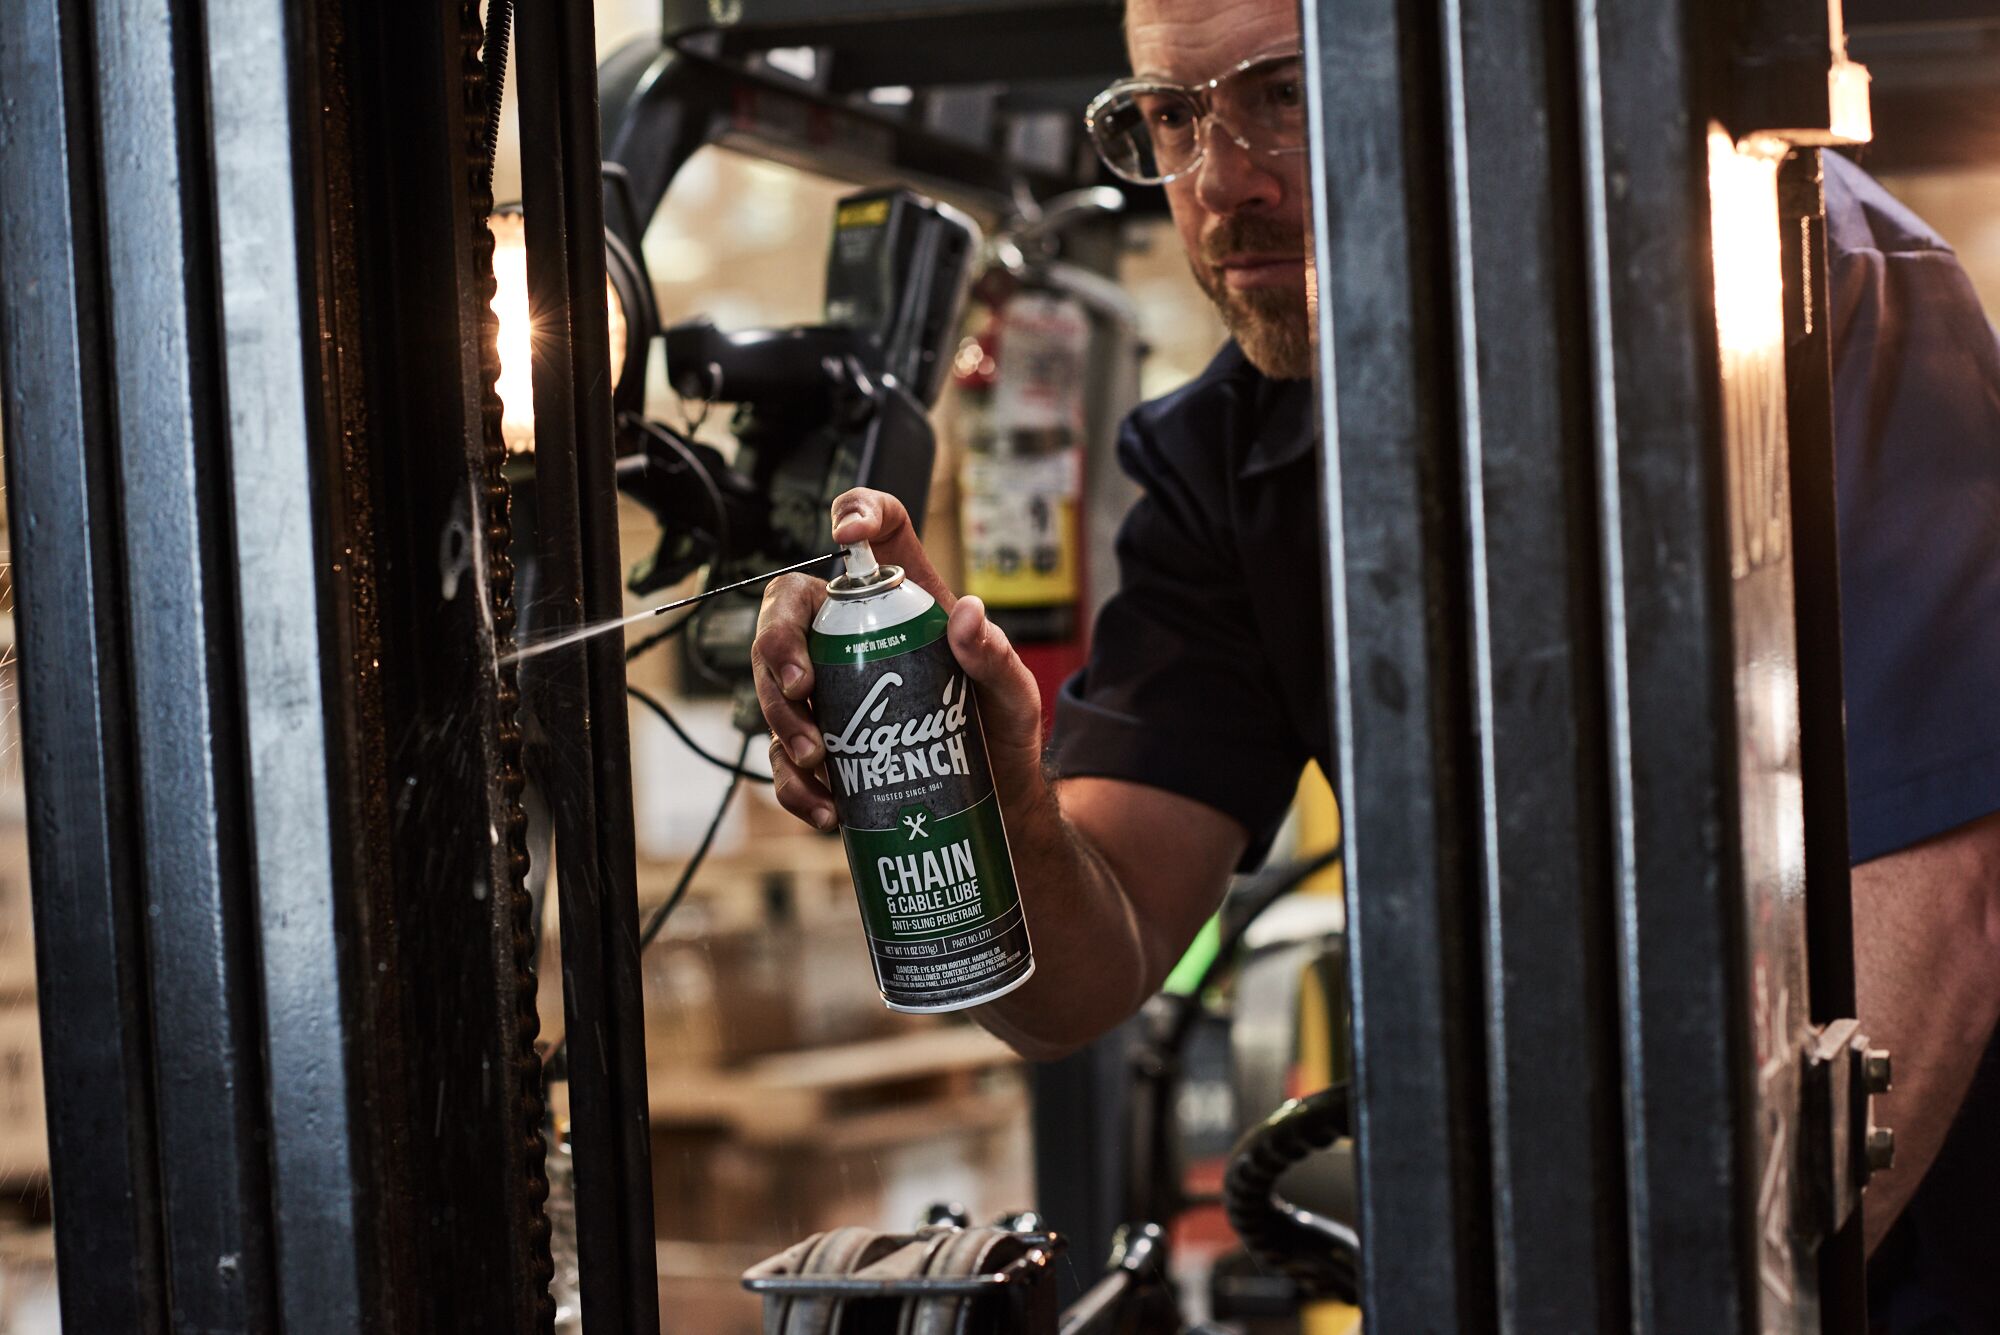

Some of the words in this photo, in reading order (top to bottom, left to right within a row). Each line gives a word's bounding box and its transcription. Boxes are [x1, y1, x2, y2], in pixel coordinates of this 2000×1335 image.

[853, 642, 869, 653] MADE
[869, 641, 876, 651] IN
[876, 638, 888, 650] THE
[887, 636, 900, 646] USA
[823, 672, 967, 774] Liquid
[835, 733, 970, 797] WRENCH
[872, 792, 904, 802] TRUSTED
[906, 787, 926, 798] SINCE
[928, 782, 943, 792] 1941
[877, 838, 976, 895] CHAIN
[886, 896, 896, 914] &
[898, 890, 944, 914] CABLE
[945, 878, 980, 906] LUBE
[892, 916, 936, 931] ANTI-SLING
[936, 902, 982, 926] PENETRANT
[904, 946, 910, 956] 11
[910, 946, 918, 955] OZ
[952, 936, 968, 948] PART
[979, 928, 992, 940] L711
[896, 965, 920, 974] DANGER:
[921, 966, 930, 974] EYE
[935, 964, 948, 972] SKIN
[972, 950, 994, 963] HARMFUL
[994, 946, 1000, 954] OR
[942, 966, 968, 978] CONTENTS
[968, 961, 985, 972] UNDER
